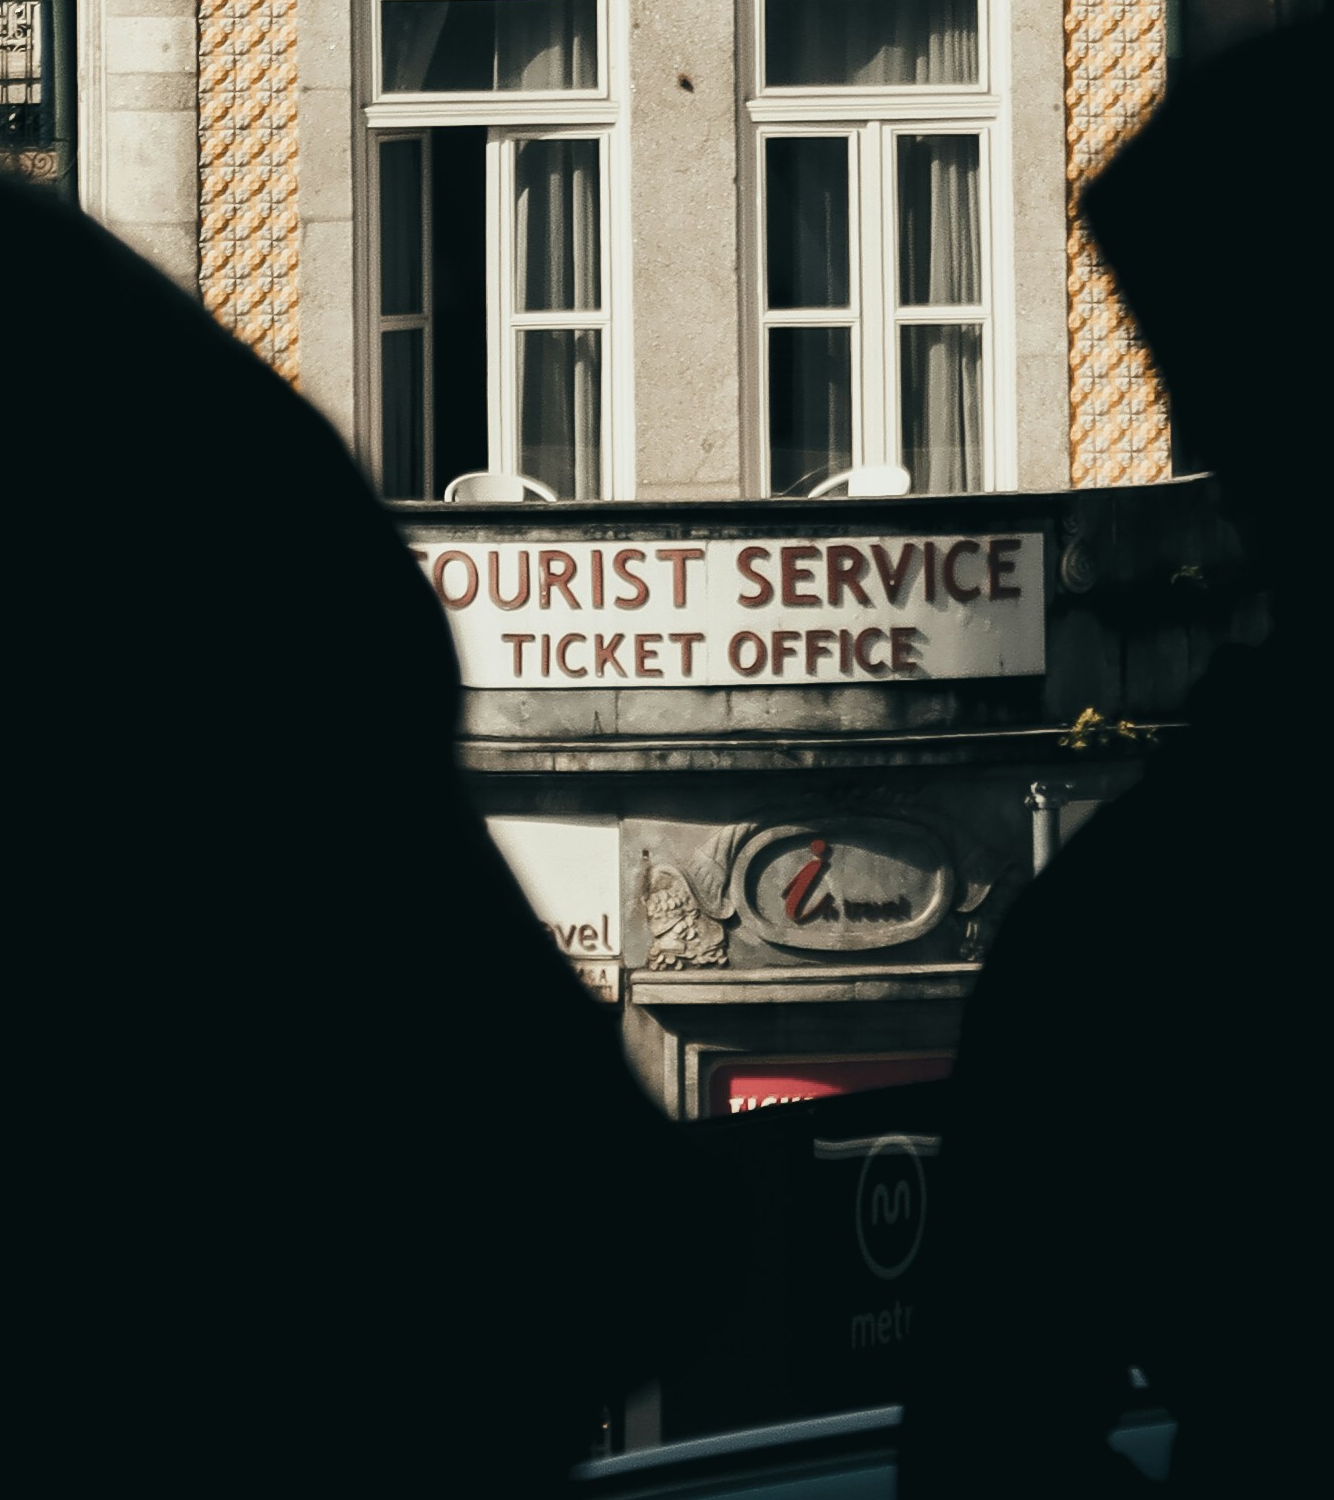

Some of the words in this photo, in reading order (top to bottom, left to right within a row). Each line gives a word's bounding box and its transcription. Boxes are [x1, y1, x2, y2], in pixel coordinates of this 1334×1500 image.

[414, 548, 705, 612] OURIST
[737, 539, 1022, 609] SERVICE
[501, 632, 706, 679] TICKET
[728, 627, 919, 678] OFFICE
